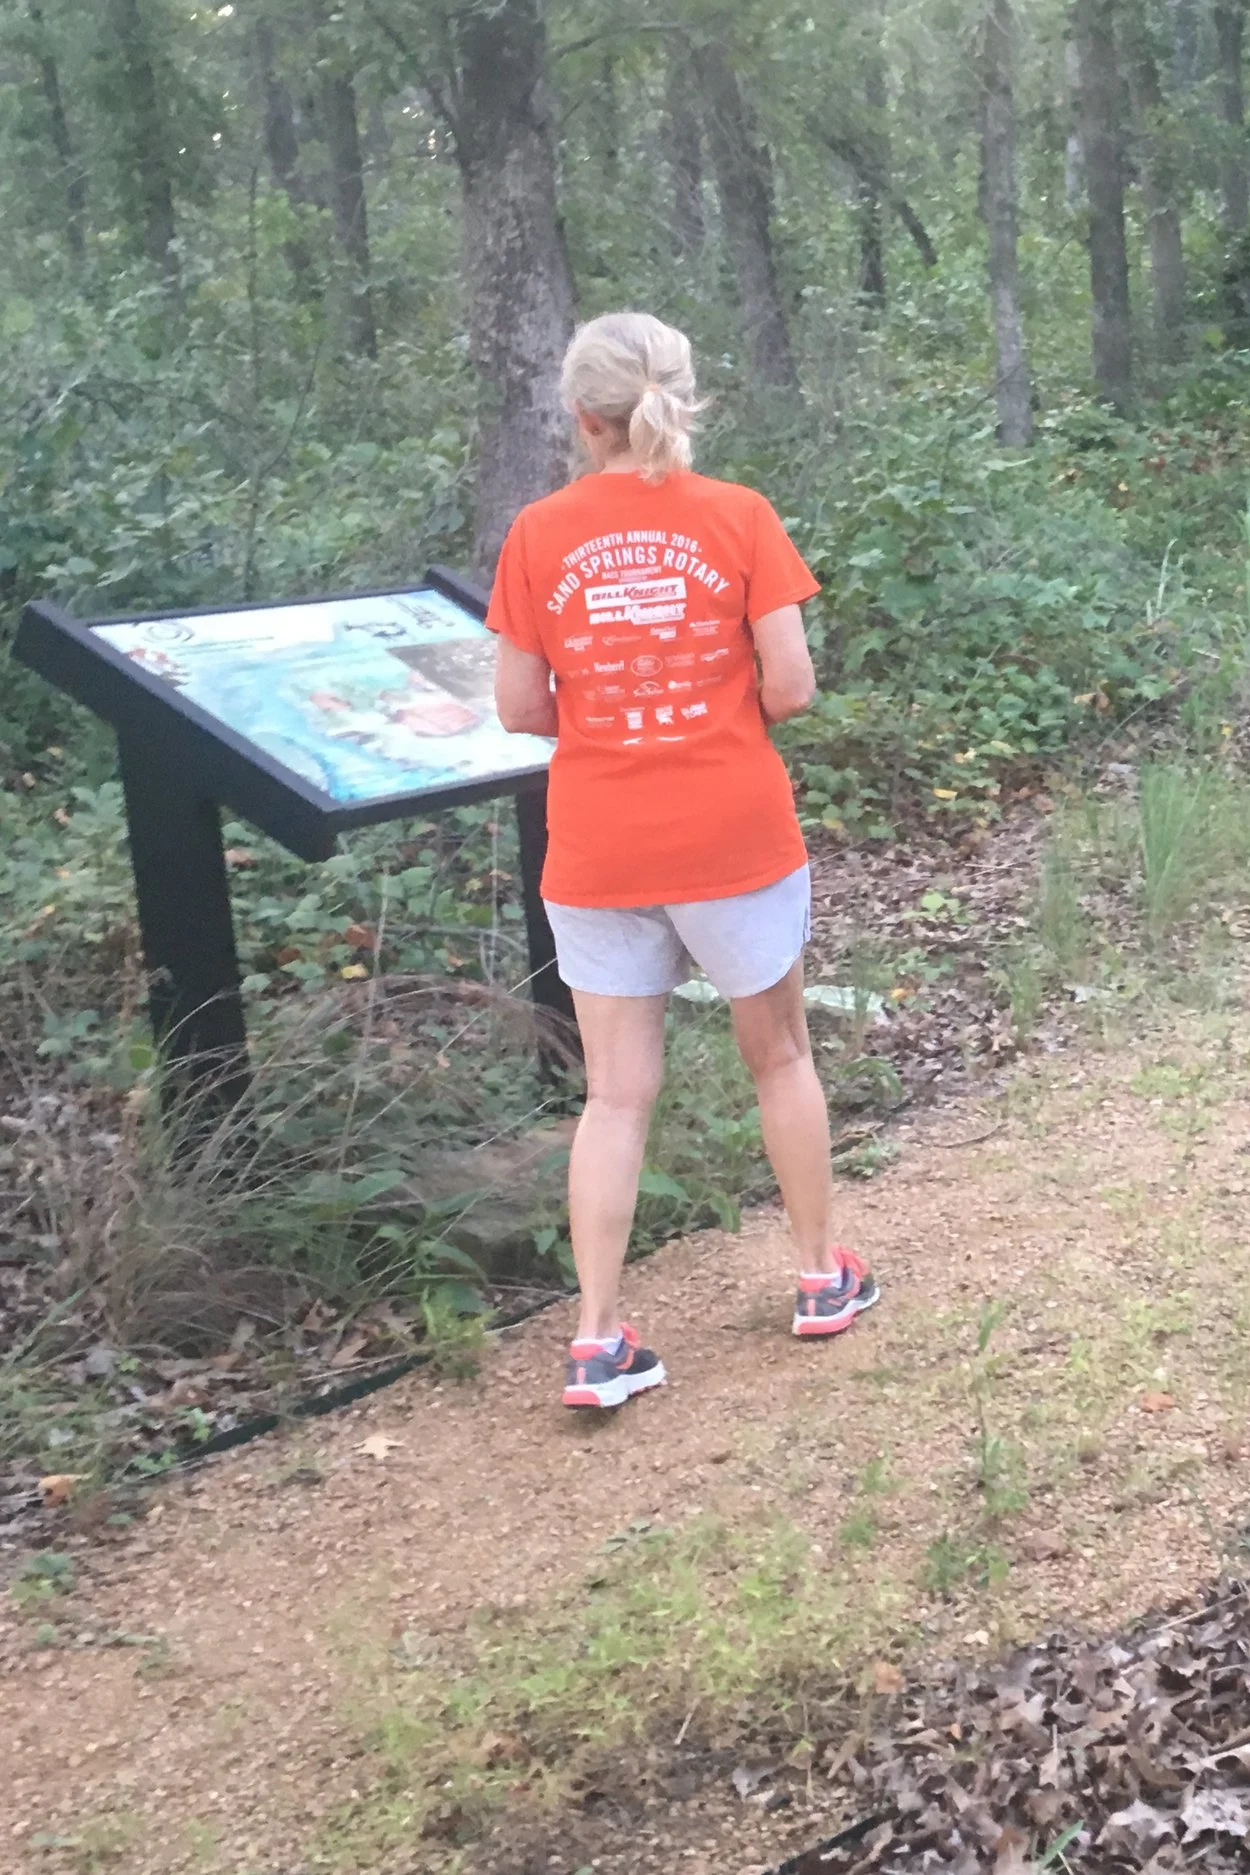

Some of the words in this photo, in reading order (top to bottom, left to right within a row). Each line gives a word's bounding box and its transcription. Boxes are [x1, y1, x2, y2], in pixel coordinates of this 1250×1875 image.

[562, 532, 624, 569] THIRTEENTH
[627, 530, 668, 545] ANNUAL
[670, 533, 699, 553] 2016
[547, 572, 581, 615] SAND
[580, 545, 657, 579] SPRINGS
[663, 548, 730, 594] ROTARY
